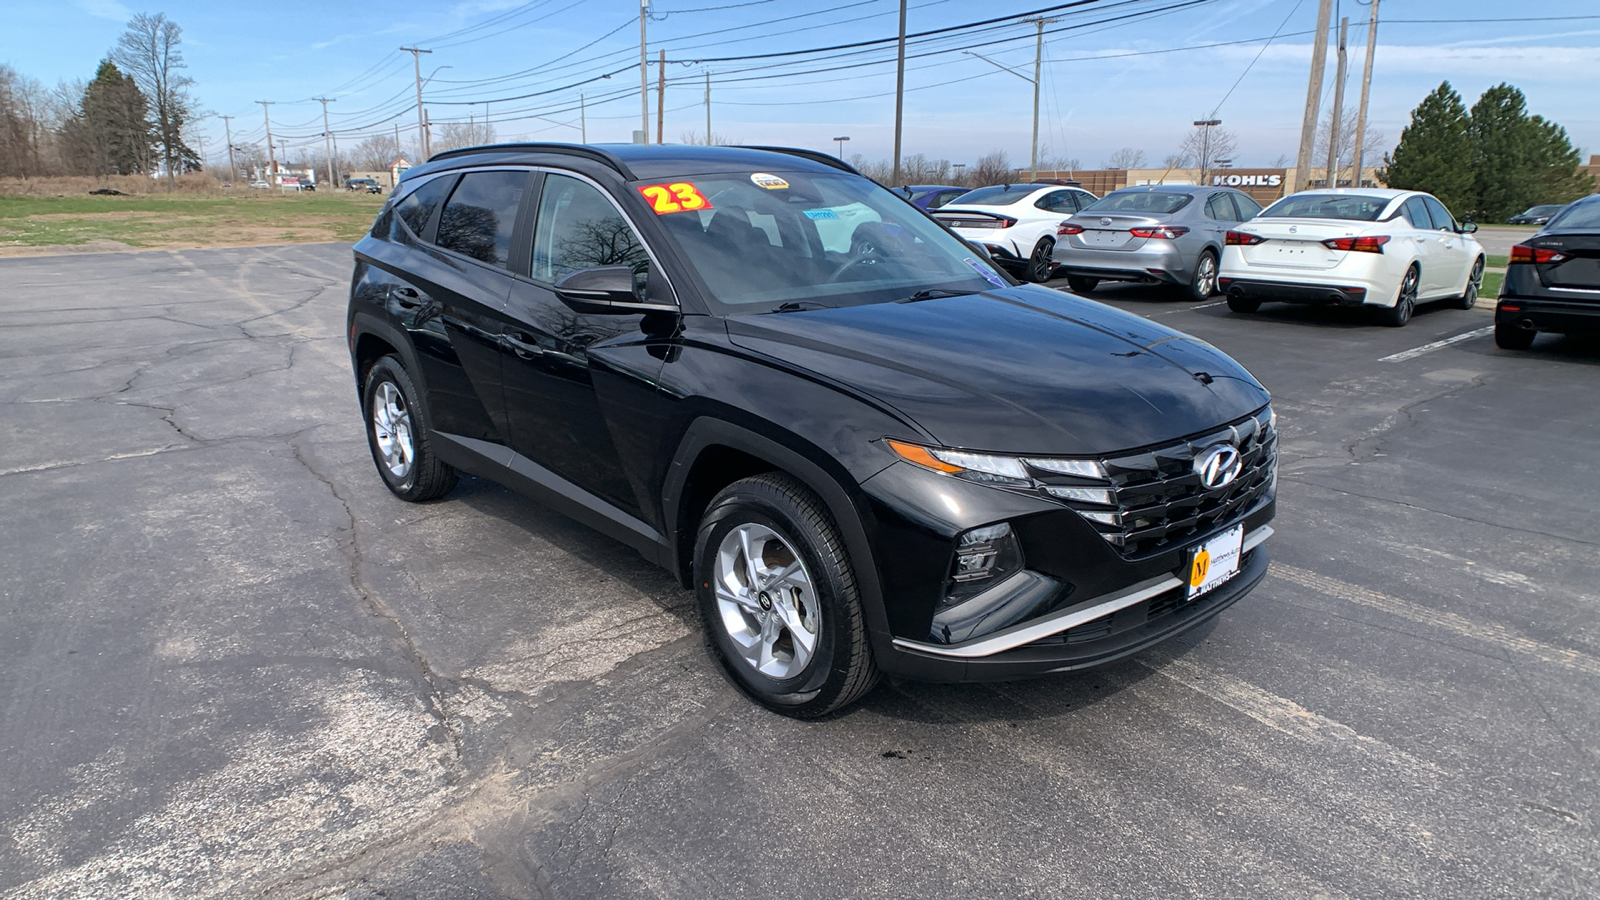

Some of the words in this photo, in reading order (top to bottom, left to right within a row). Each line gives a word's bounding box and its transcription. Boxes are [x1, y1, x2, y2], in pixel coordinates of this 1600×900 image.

[1213, 174, 1281, 186] KOHL'S
[643, 183, 706, 213] 23
[1193, 557, 1208, 581] M
[1201, 572, 1231, 595] MATTHEWS
